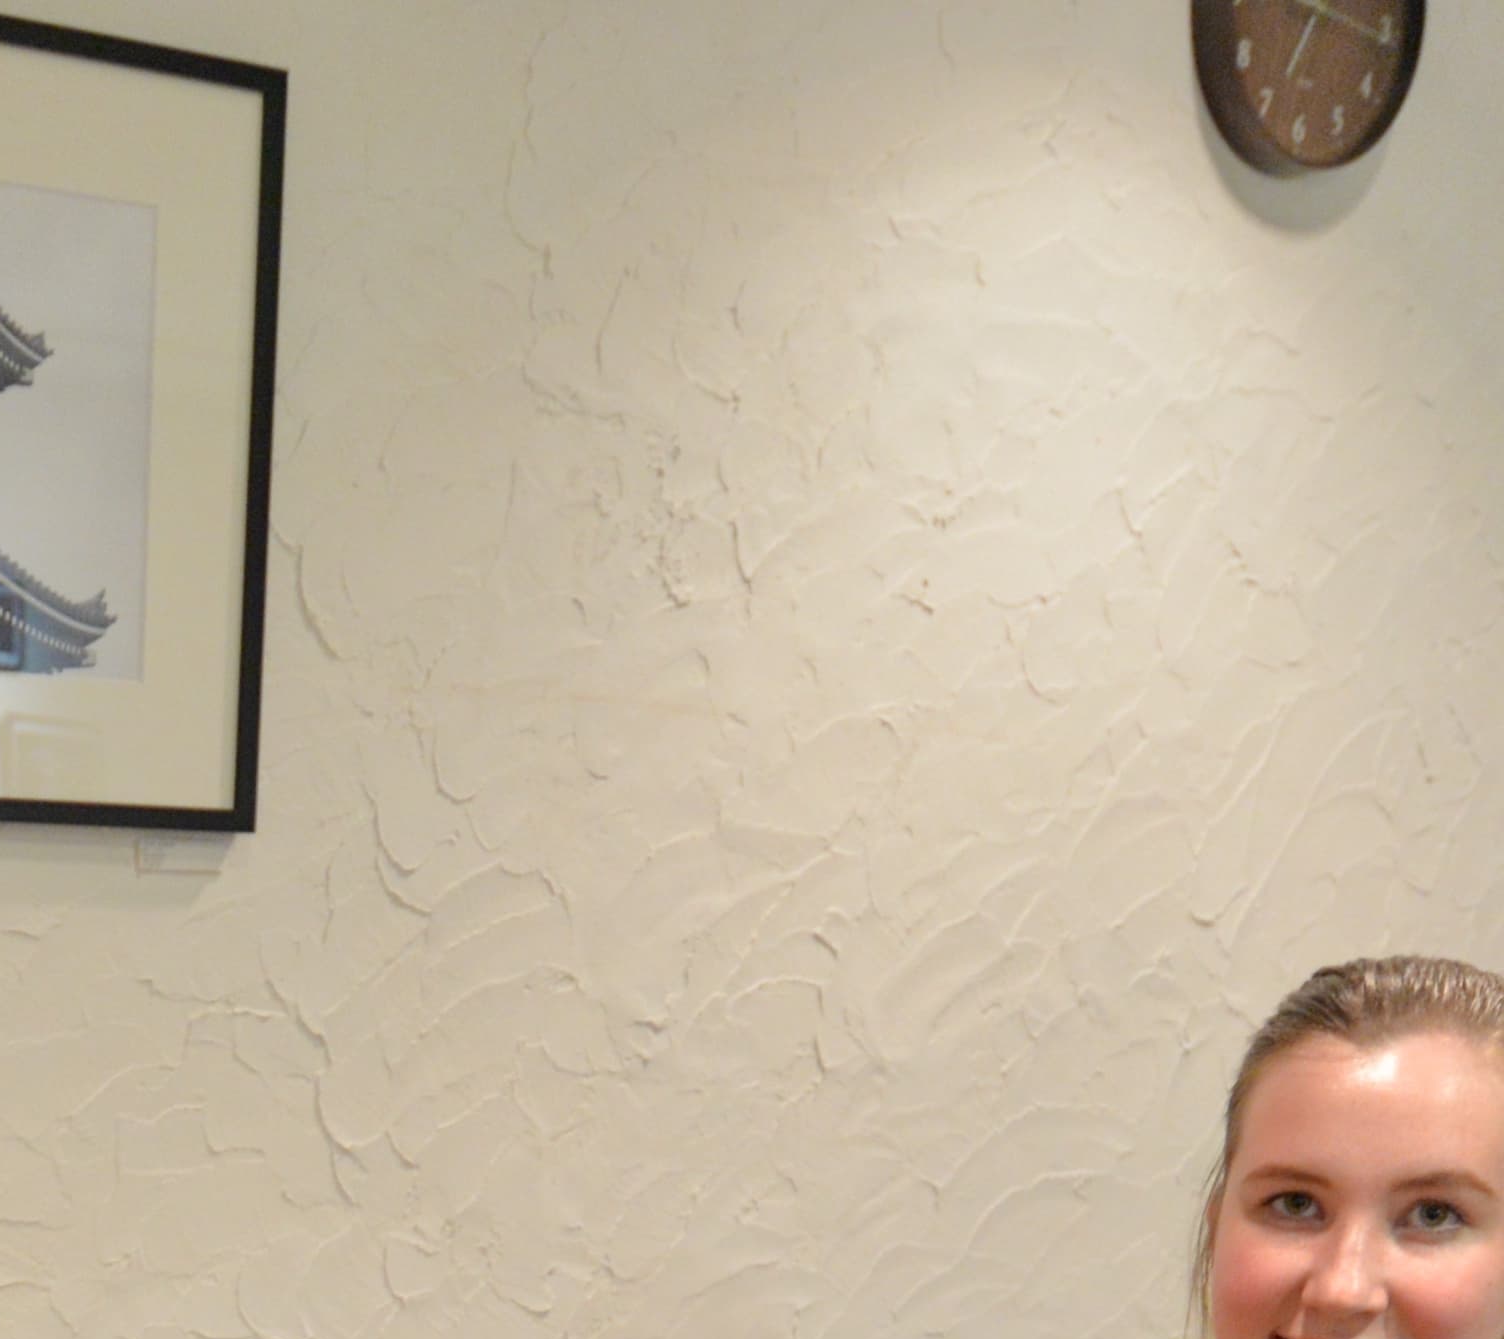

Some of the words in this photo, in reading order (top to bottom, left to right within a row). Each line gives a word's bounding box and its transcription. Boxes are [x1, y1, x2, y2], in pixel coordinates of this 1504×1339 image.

[1235, 38, 1252, 70] 8
[1260, 87, 1274, 119] 7
[1293, 114, 1307, 144] 6
